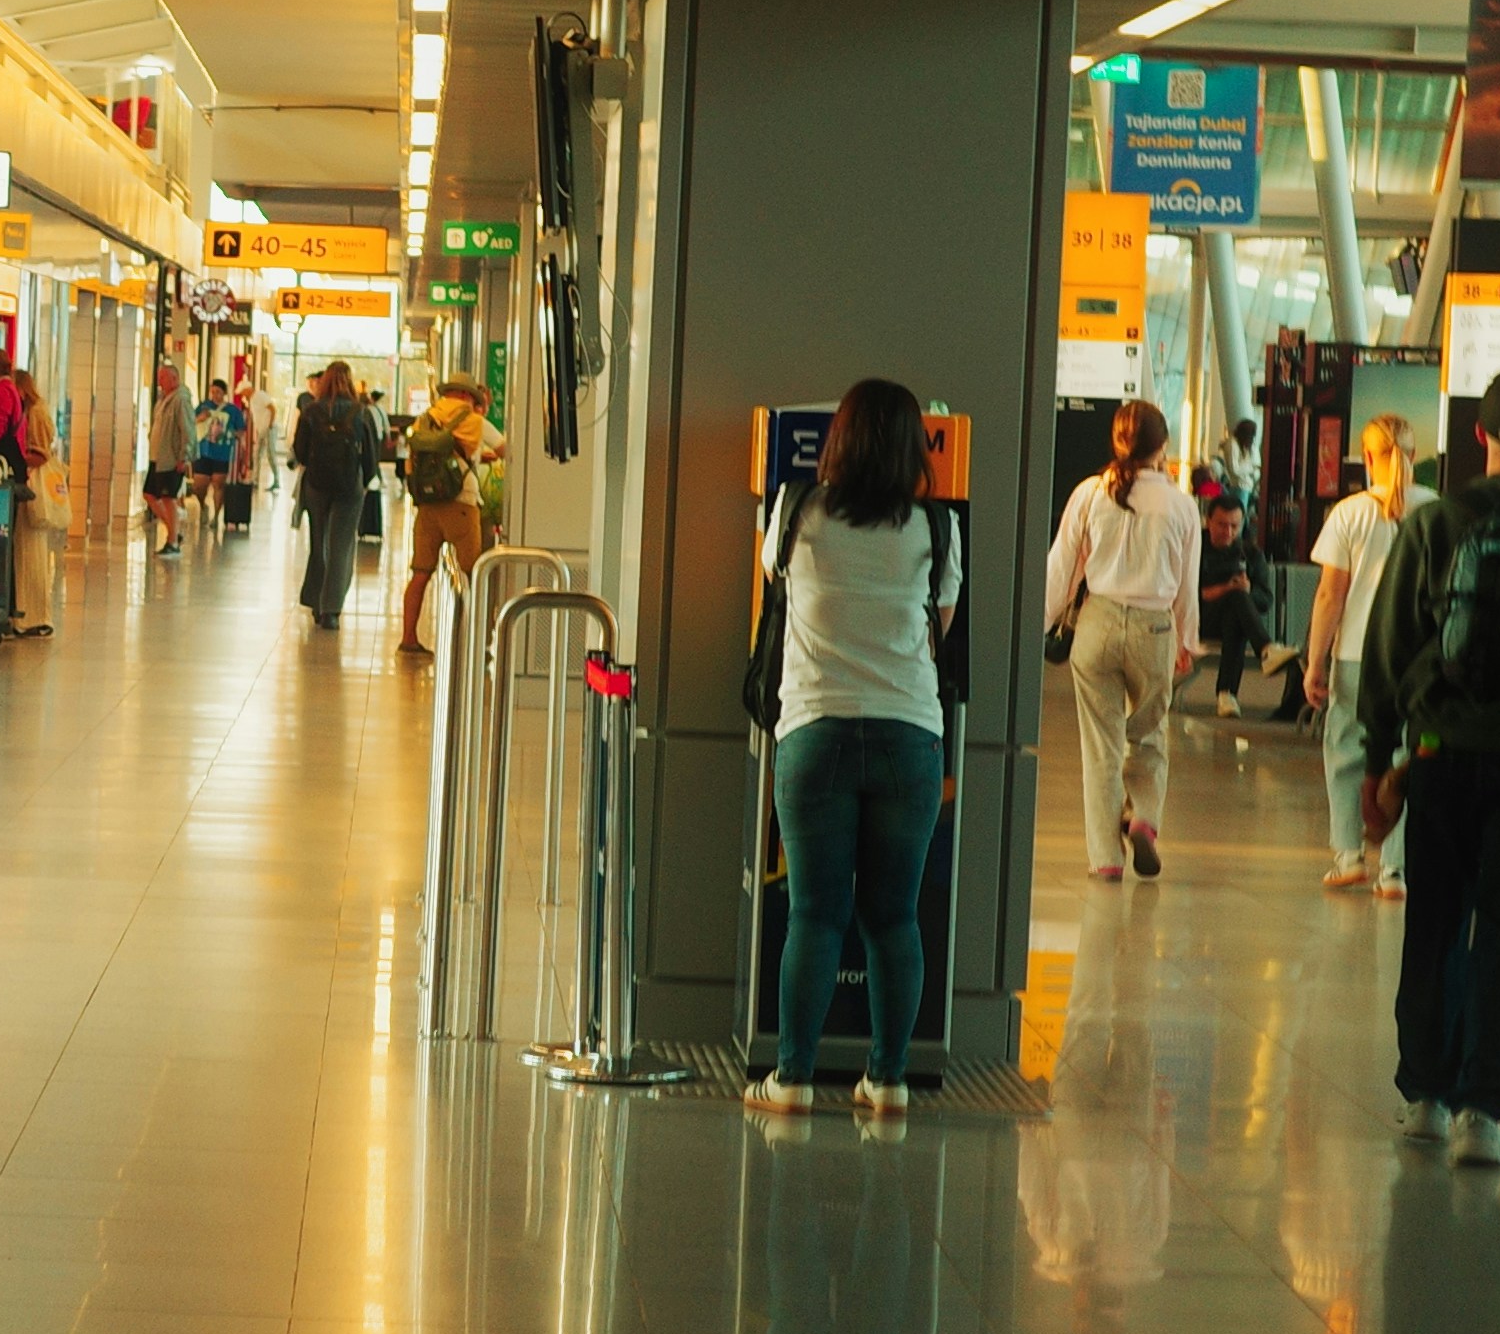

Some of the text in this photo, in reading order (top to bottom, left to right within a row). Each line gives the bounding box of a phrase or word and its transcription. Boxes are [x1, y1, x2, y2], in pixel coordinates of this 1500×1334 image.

[1126, 114, 1247, 137] Tajlandia Dubaj
[1128, 133, 1242, 152] Zanzibar Kenia
[1136, 152, 1232, 171] Dominikana
[1150, 192, 1244, 217] kacje.pl
[251, 235, 328, 258] 40–45
[490, 237, 514, 250] AED
[1072, 230, 1133, 250] 39 38
